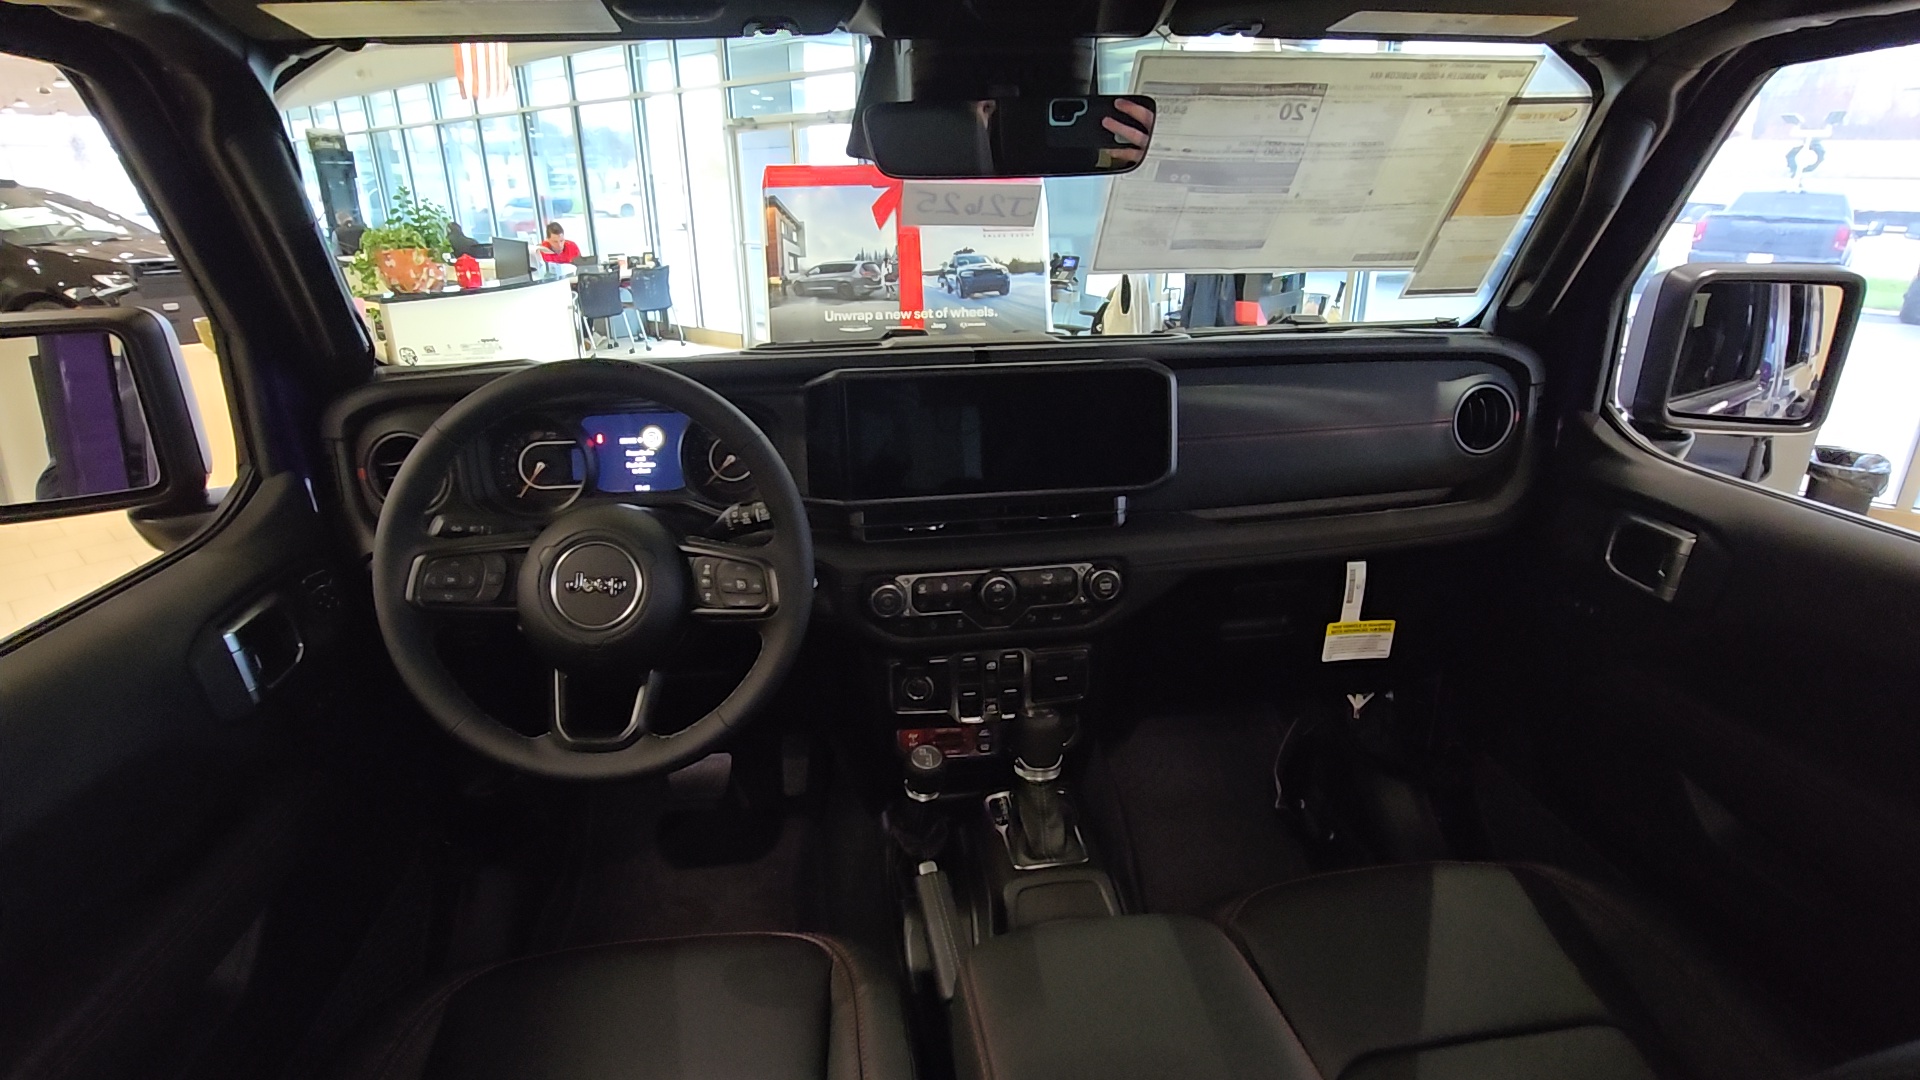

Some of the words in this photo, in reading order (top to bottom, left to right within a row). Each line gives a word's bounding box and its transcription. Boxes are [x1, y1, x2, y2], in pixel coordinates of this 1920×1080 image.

[824, 310, 873, 323] Unwrap
[875, 312, 883, 320] a
[885, 311, 912, 320] new
[914, 309, 934, 320] set
[935, 307, 948, 319] of
[950, 306, 998, 318] wheels.
[565, 572, 627, 595] Jeep
